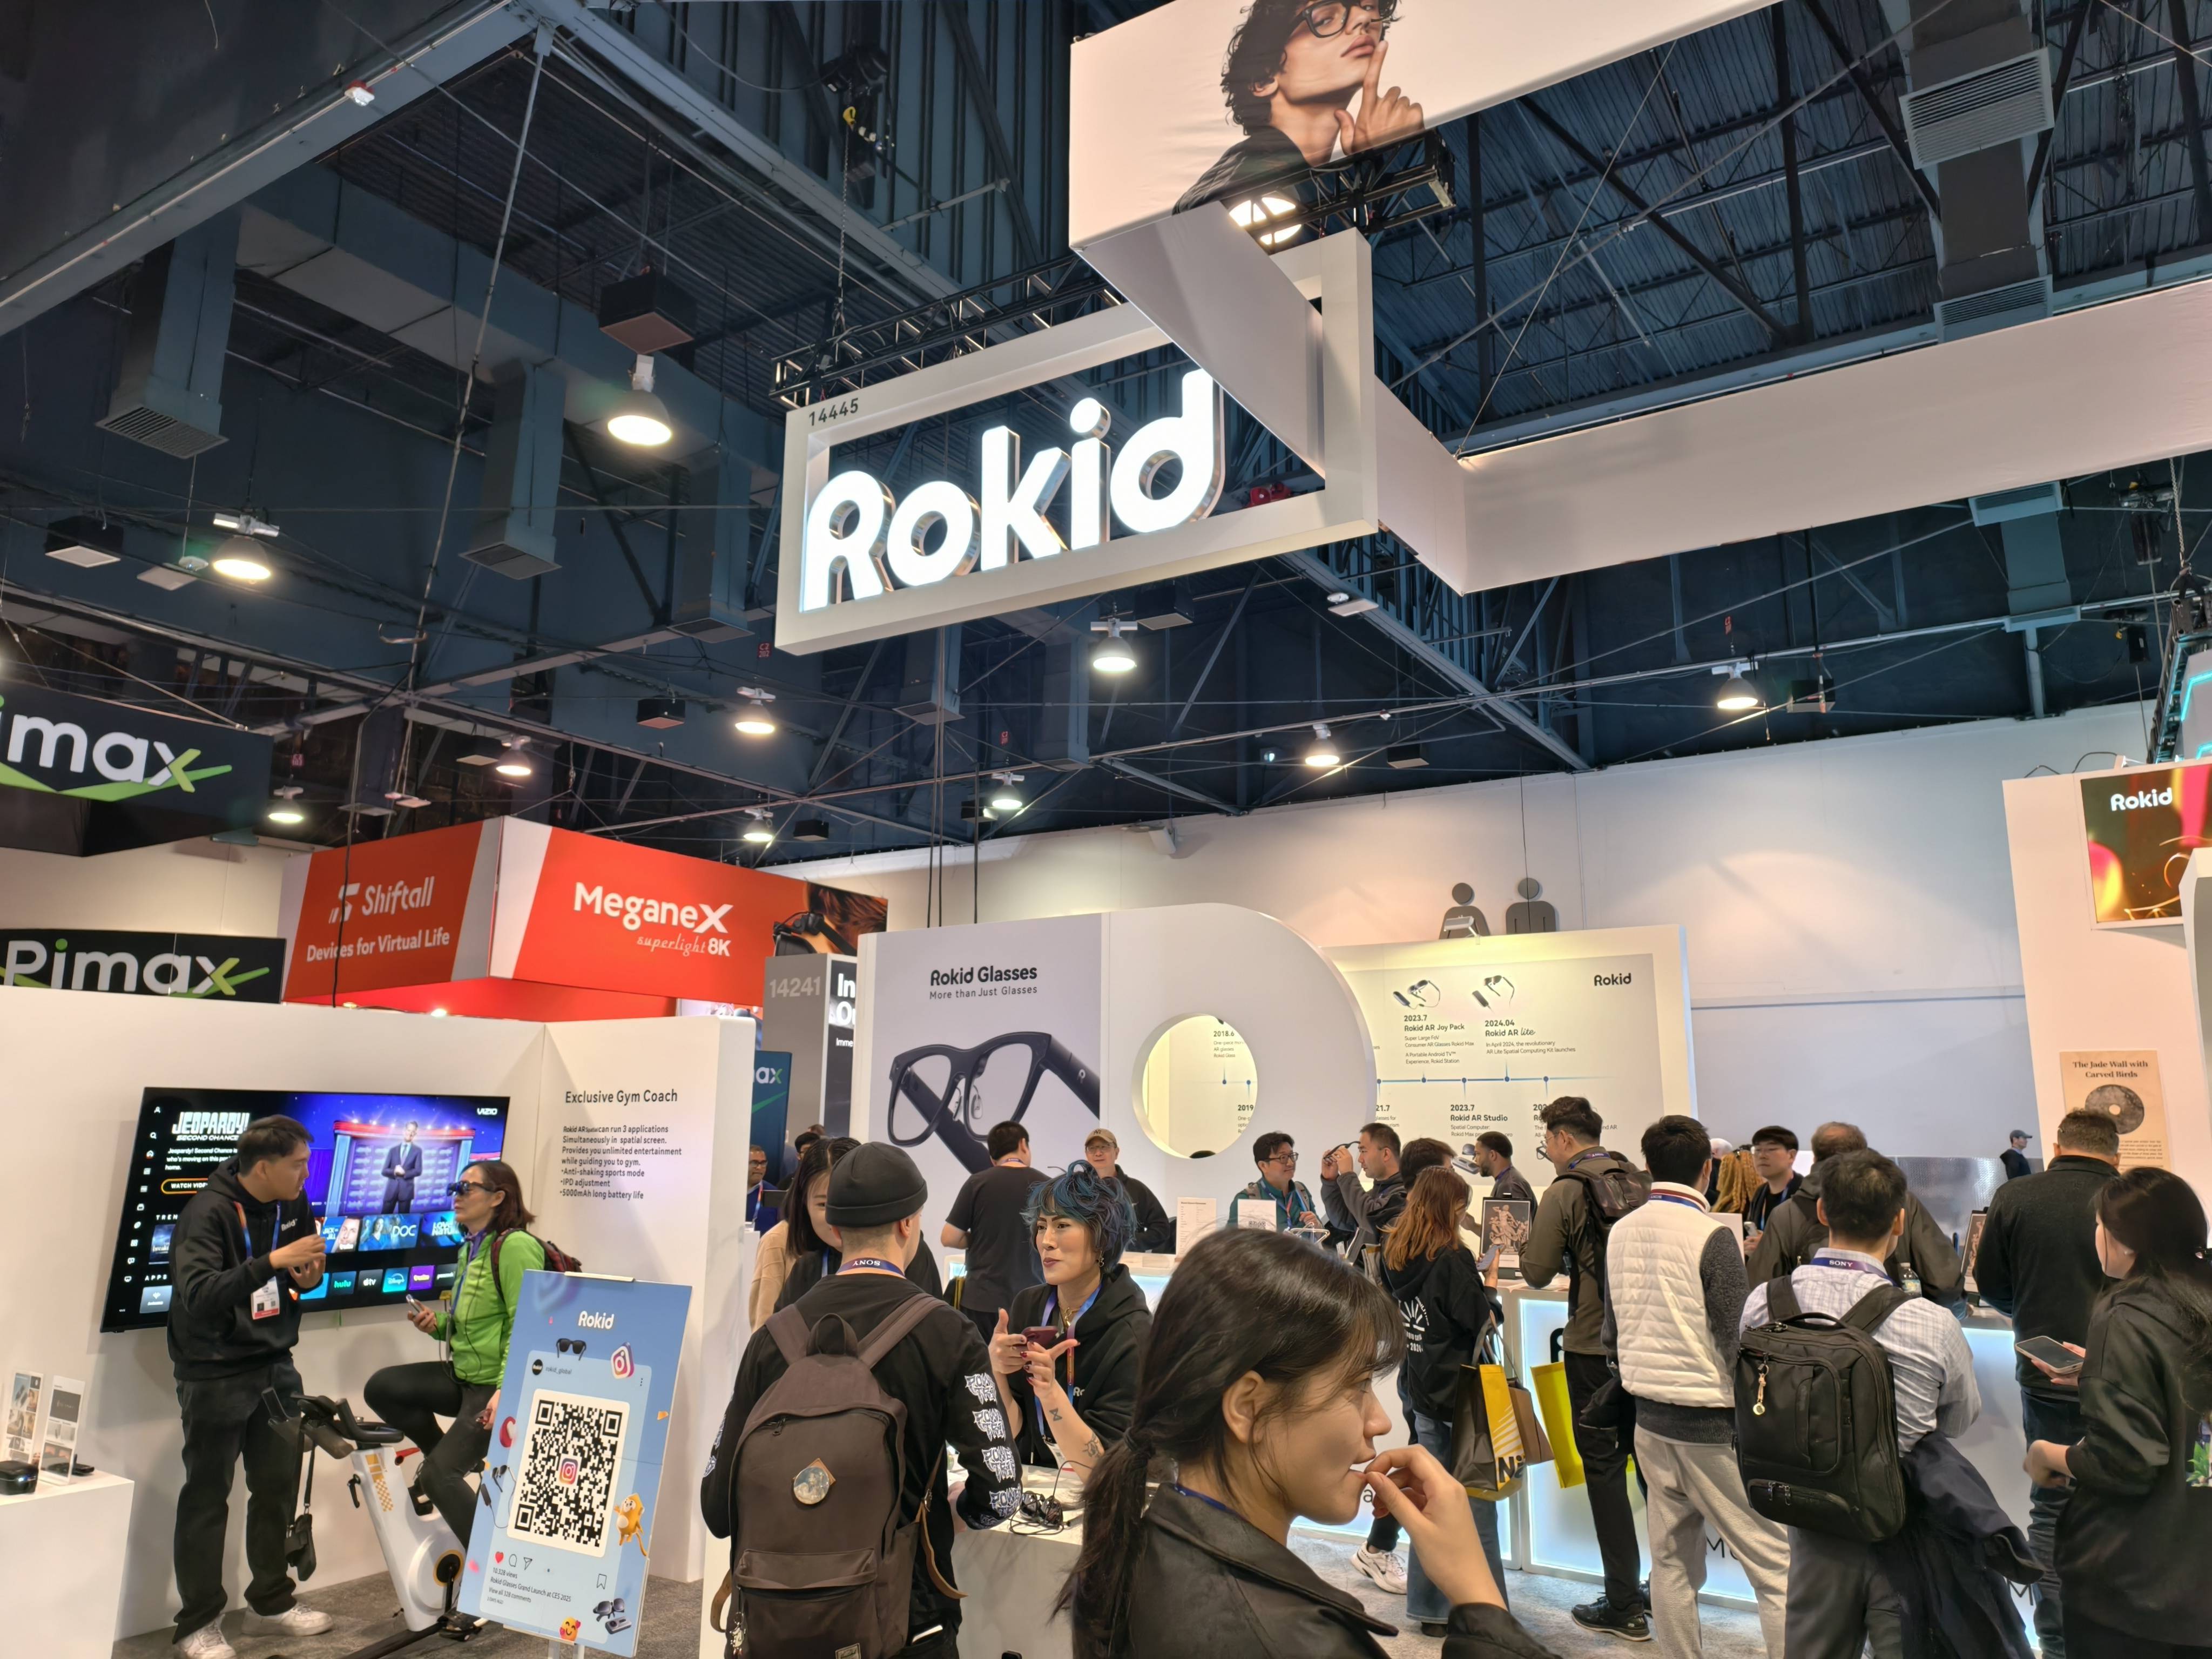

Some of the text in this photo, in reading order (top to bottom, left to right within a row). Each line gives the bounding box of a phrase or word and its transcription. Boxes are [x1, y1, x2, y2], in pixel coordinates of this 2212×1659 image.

[809, 397, 860, 427] 14445
[799, 367, 1224, 613] Rokid
[0, 694, 201, 793] max
[2110, 787, 2173, 811] Rokid
[361, 876, 435, 916] Shiftall
[574, 881, 734, 934] MeganeX
[306, 926, 450, 962] Devices for Virtual Life
[636, 933, 731, 957] superlight 8K
[6, 939, 240, 996] Pimax
[930, 965, 1038, 986] Rokid Glasses
[769, 976, 821, 999] 14241
[1594, 973, 1631, 986] Rokid
[929, 984, 1038, 1000] More than Just Glasses
[1437, 1024, 1448, 1032] Joy
[1520, 1027, 1536, 1036] lite
[2115, 1070, 2138, 1078] Birds
[565, 1089, 678, 1105] Exclusive Gym Coach
[171, 1111, 250, 1135] JEOPARDY!
[628, 1125, 669, 1135] applications
[563, 1136, 610, 1145] Simultaneously
[620, 1136, 643, 1145] spatial
[562, 1146, 682, 1156] Provides you unlimited entertainment
[579, 1157, 603, 1167] guiding
[603, 1158, 615, 1167] you
[625, 1159, 640, 1168] gym.
[605, 1169, 626, 1178] sports
[575, 1179, 610, 1188] adjustment
[592, 1190, 606, 1199] long
[608, 1190, 632, 1201] battery
[392, 1224, 417, 1237] DOC
[578, 1310, 615, 1330] Rokid
[490, 1576, 502, 1585] Rokid
[502, 1579, 517, 1589] Glasses
[517, 1583, 530, 1592] Grand
[531, 1587, 546, 1596] Launch
[560, 1594, 572, 1602] 2025
[511, 1593, 531, 1603] comments
